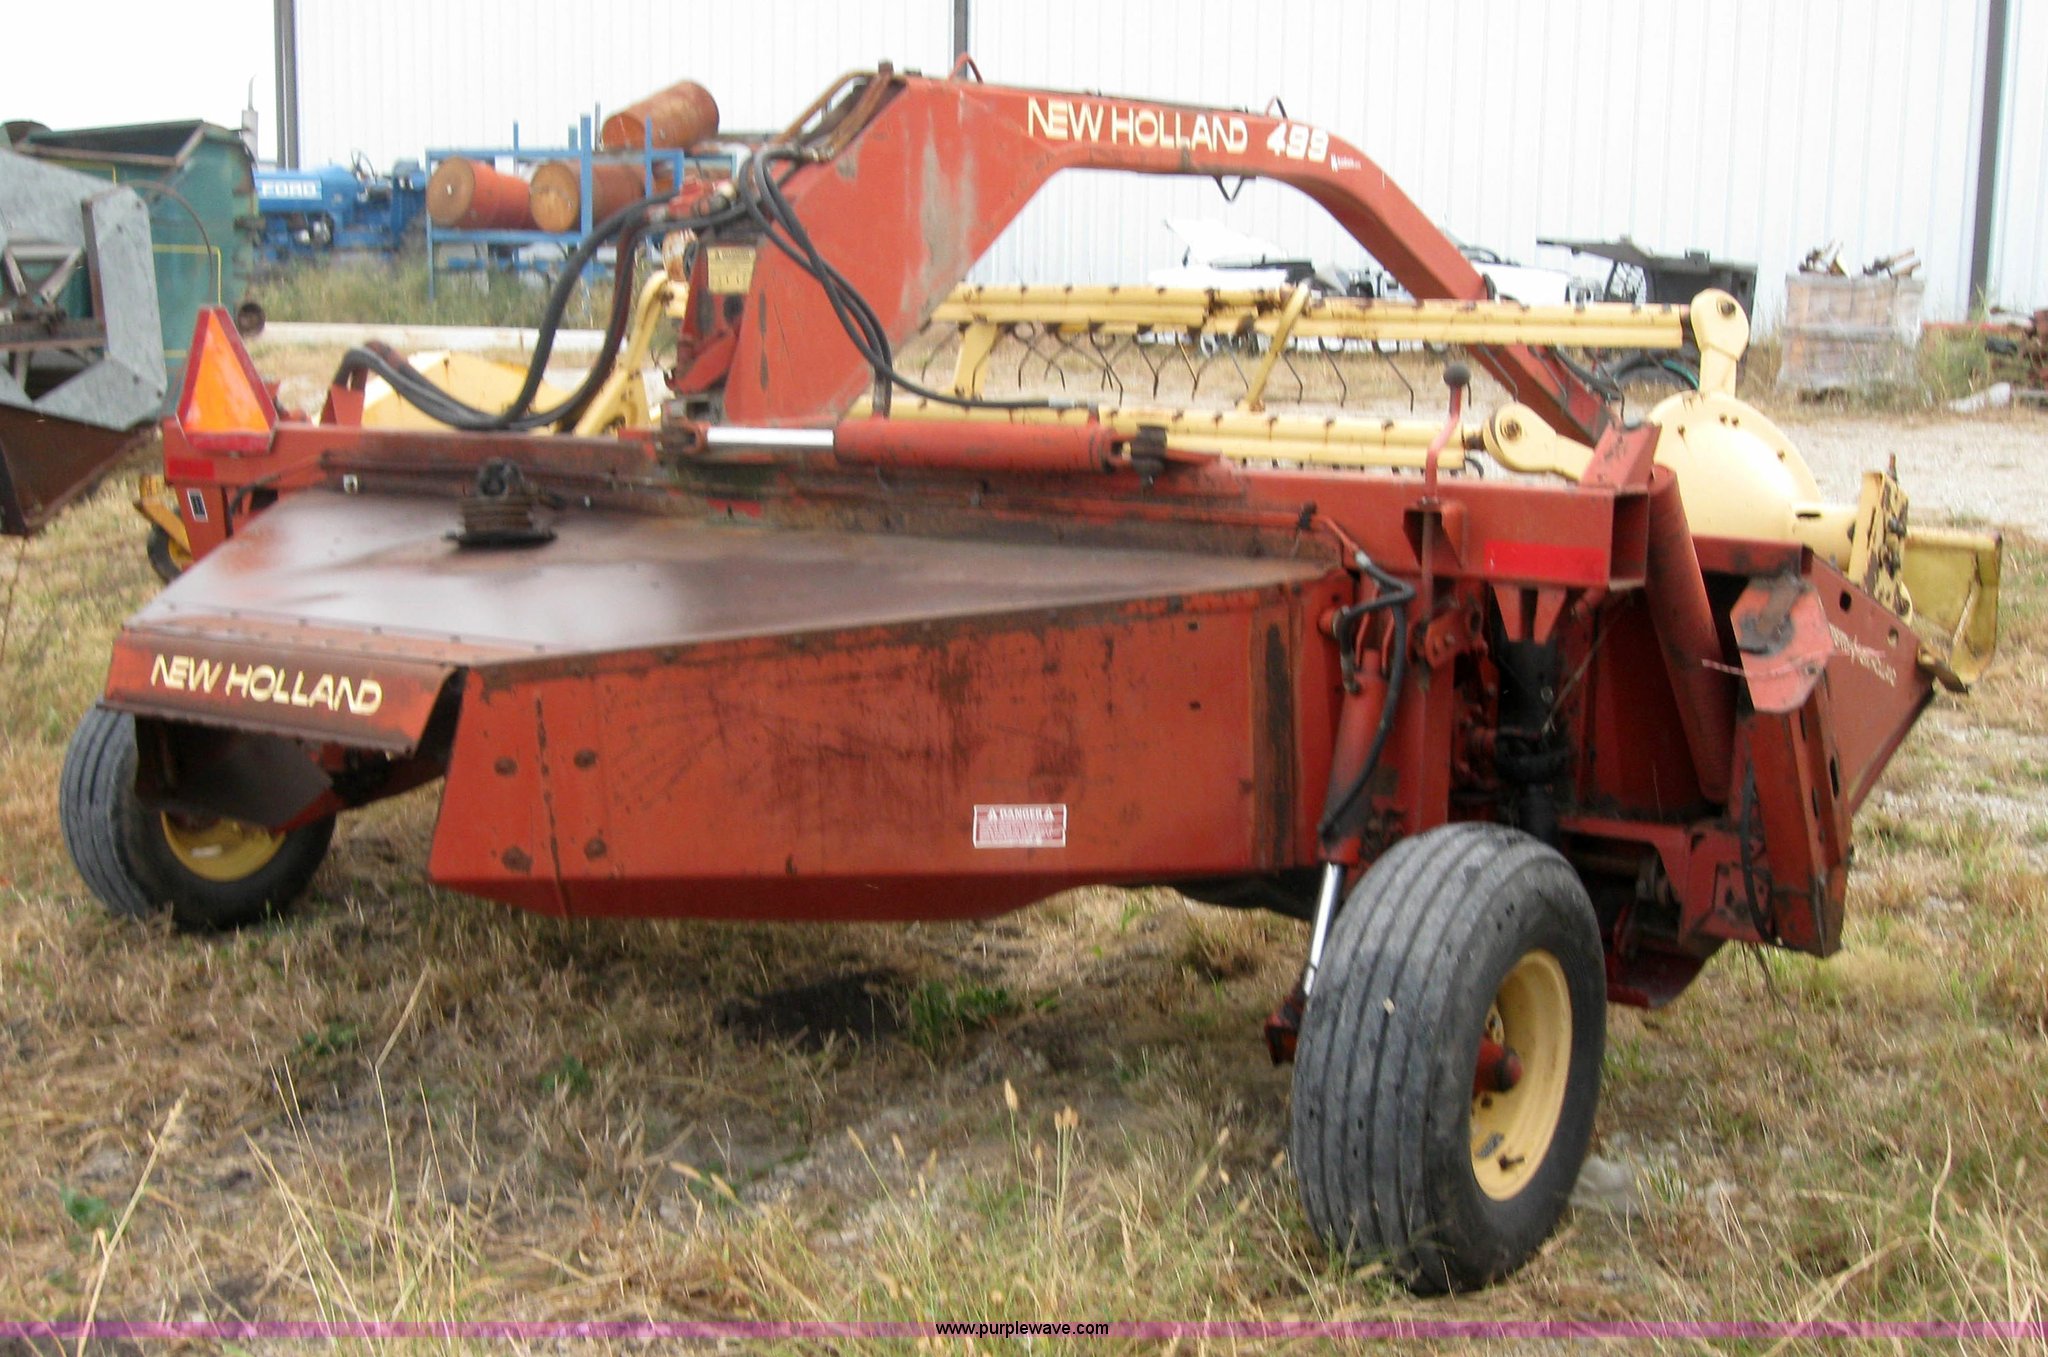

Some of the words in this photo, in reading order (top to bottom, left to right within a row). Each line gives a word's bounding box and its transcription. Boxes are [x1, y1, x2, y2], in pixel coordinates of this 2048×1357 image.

[1027, 96, 1104, 143] NEW
[1111, 105, 1249, 154] HOLLAND
[1266, 123, 1330, 163] 499
[261, 179, 317, 198] FORD
[150, 653, 224, 694] NEW
[225, 662, 383, 716] HOLLAND
